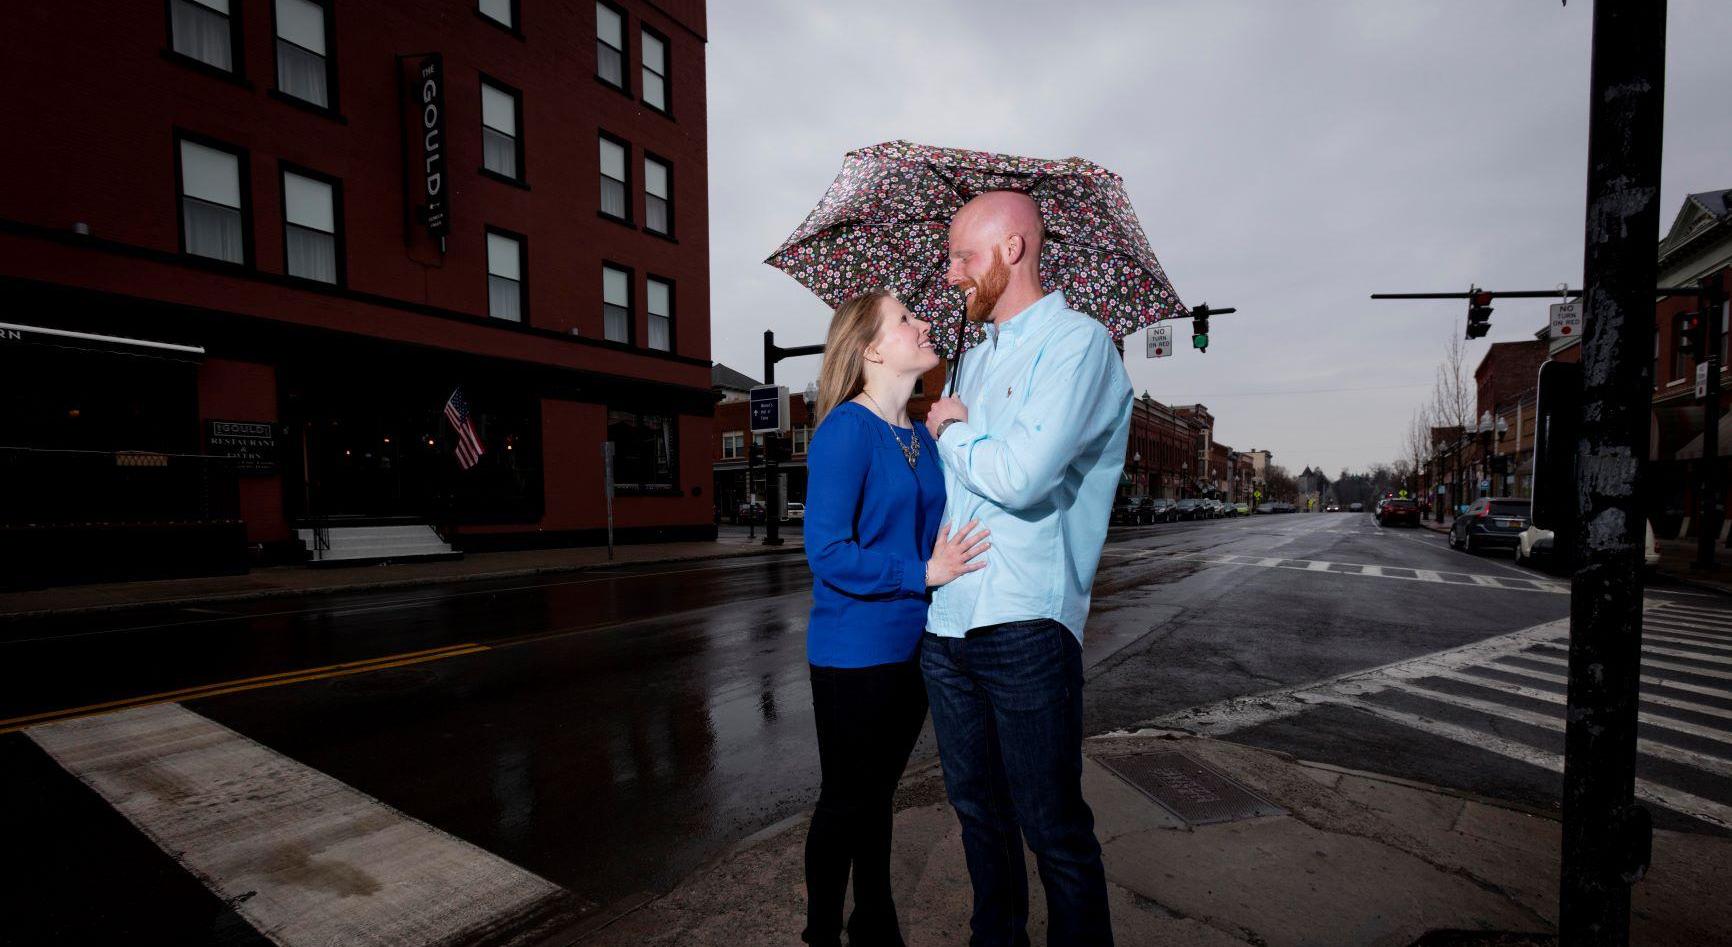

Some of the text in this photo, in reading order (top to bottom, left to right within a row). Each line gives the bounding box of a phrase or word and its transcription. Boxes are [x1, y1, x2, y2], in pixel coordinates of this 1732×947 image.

[421, 64, 438, 79] THE
[422, 79, 441, 196] GOULD
[222, 424, 265, 434] GOULD
[210, 438, 275, 447] RESTAURANT
